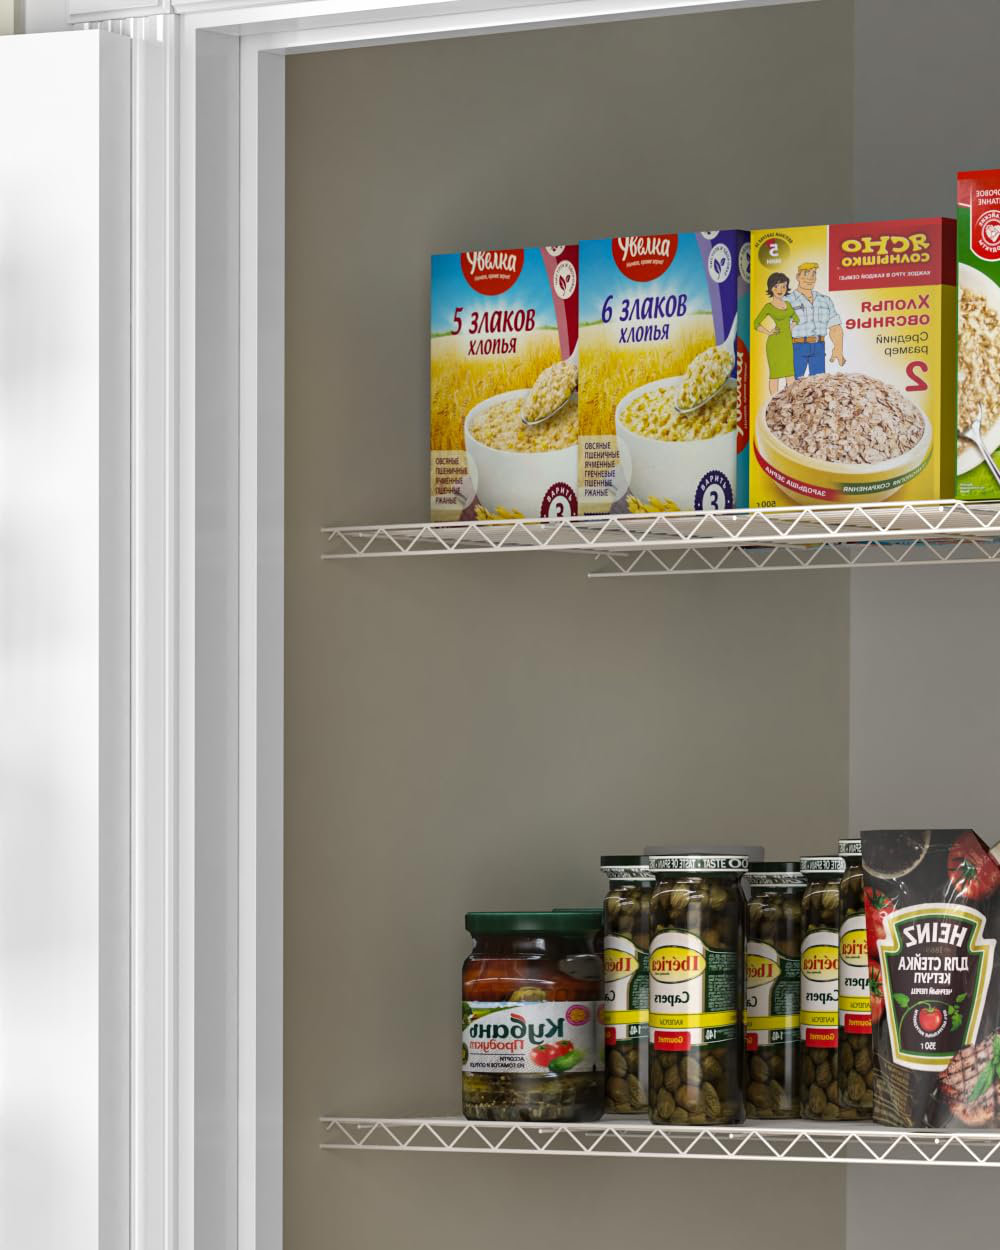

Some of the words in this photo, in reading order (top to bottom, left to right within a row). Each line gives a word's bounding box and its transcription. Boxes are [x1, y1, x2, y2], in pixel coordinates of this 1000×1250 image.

[617, 236, 671, 261] Увелка
[466, 251, 517, 275] Увелка
[601, 294, 614, 323] 6
[451, 307, 464, 335] 5
[584, 442, 611, 450] ОВСЯНЫЕ
[584, 450, 620, 459] ПШЕНИЧНЫЕ
[584, 460, 616, 468] ЯЧМЕННЫЕ
[584, 470, 616, 478] ГРЕЧНЕВЫЕ
[584, 479, 613, 487] ПШЕННЫЕ
[700, 474, 728, 491] ВАРИТЬ
[584, 488, 609, 497] РЖАНЫЕ
[710, 490, 719, 511] 3
